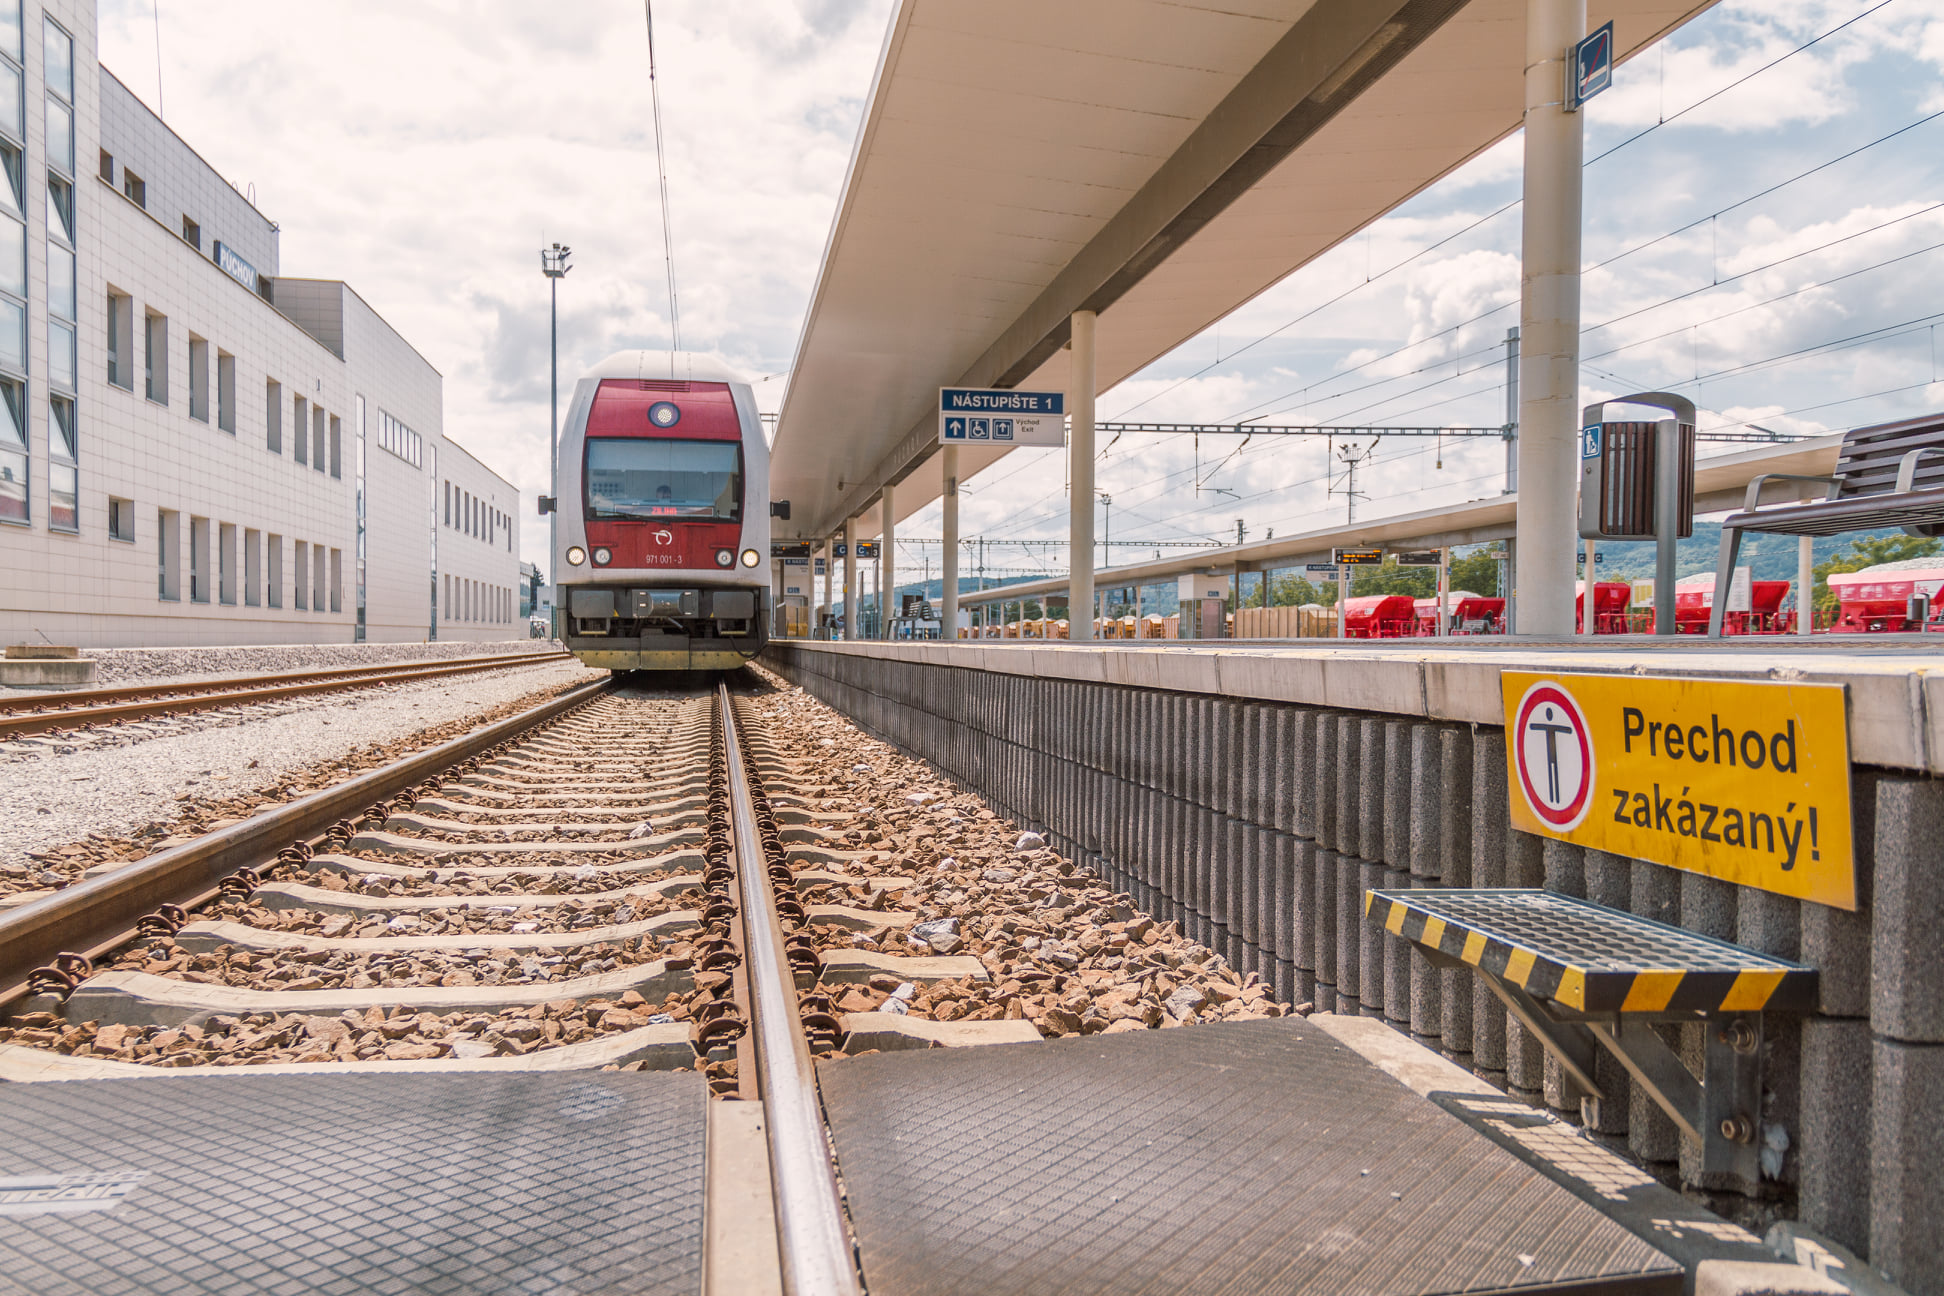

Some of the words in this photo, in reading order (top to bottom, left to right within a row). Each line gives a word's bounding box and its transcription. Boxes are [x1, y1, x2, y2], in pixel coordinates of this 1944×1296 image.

[220, 248, 254, 287] PÚCHOV
[952, 392, 1039, 409] NÁSTUPIŠTE
[1045, 398, 1052, 410] 1
[1015, 418, 1040, 426] Východ
[646, 554, 658, 564] 971
[1623, 706, 1798, 774] Prechod
[1612, 782, 1821, 871] zakázaný!
